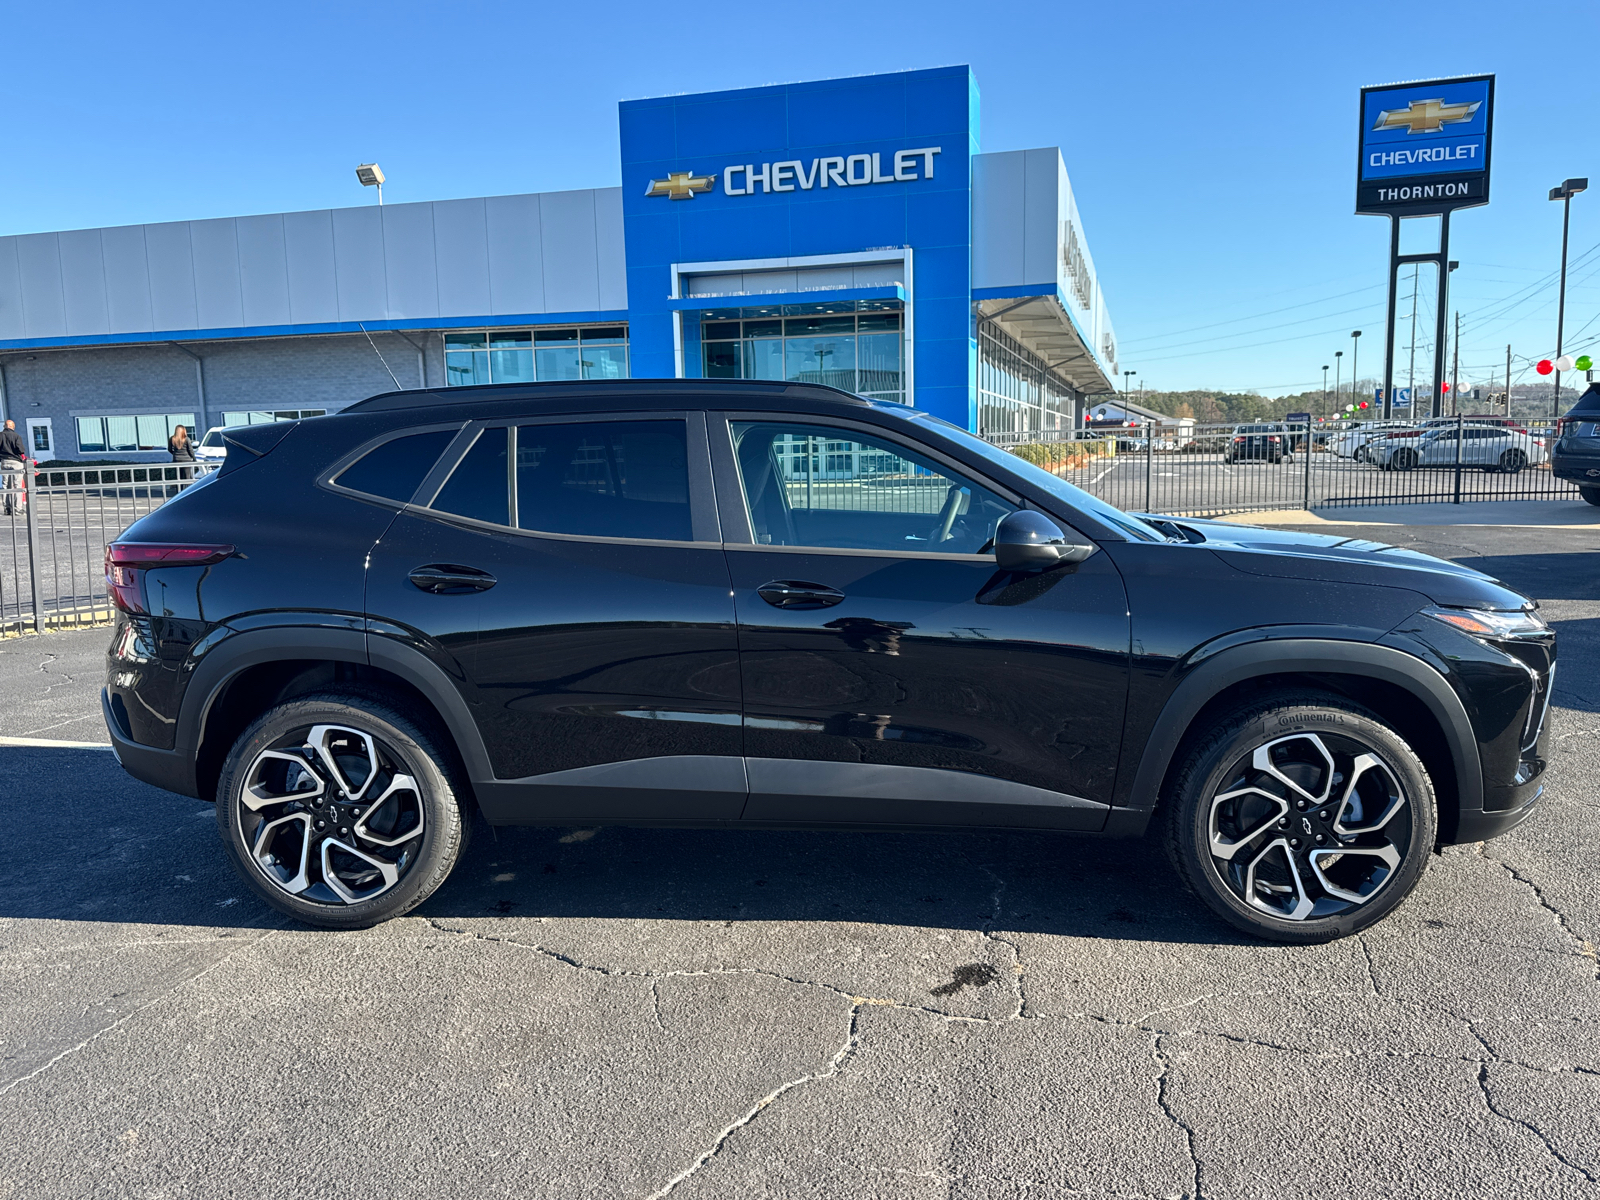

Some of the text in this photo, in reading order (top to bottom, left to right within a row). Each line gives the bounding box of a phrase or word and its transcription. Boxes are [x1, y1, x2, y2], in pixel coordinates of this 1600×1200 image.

[1370, 144, 1479, 166] CHEVROLET
[723, 146, 941, 195] CHEVROLET
[1378, 182, 1469, 201] THORNTON
[1278, 712, 1336, 726] Continental
